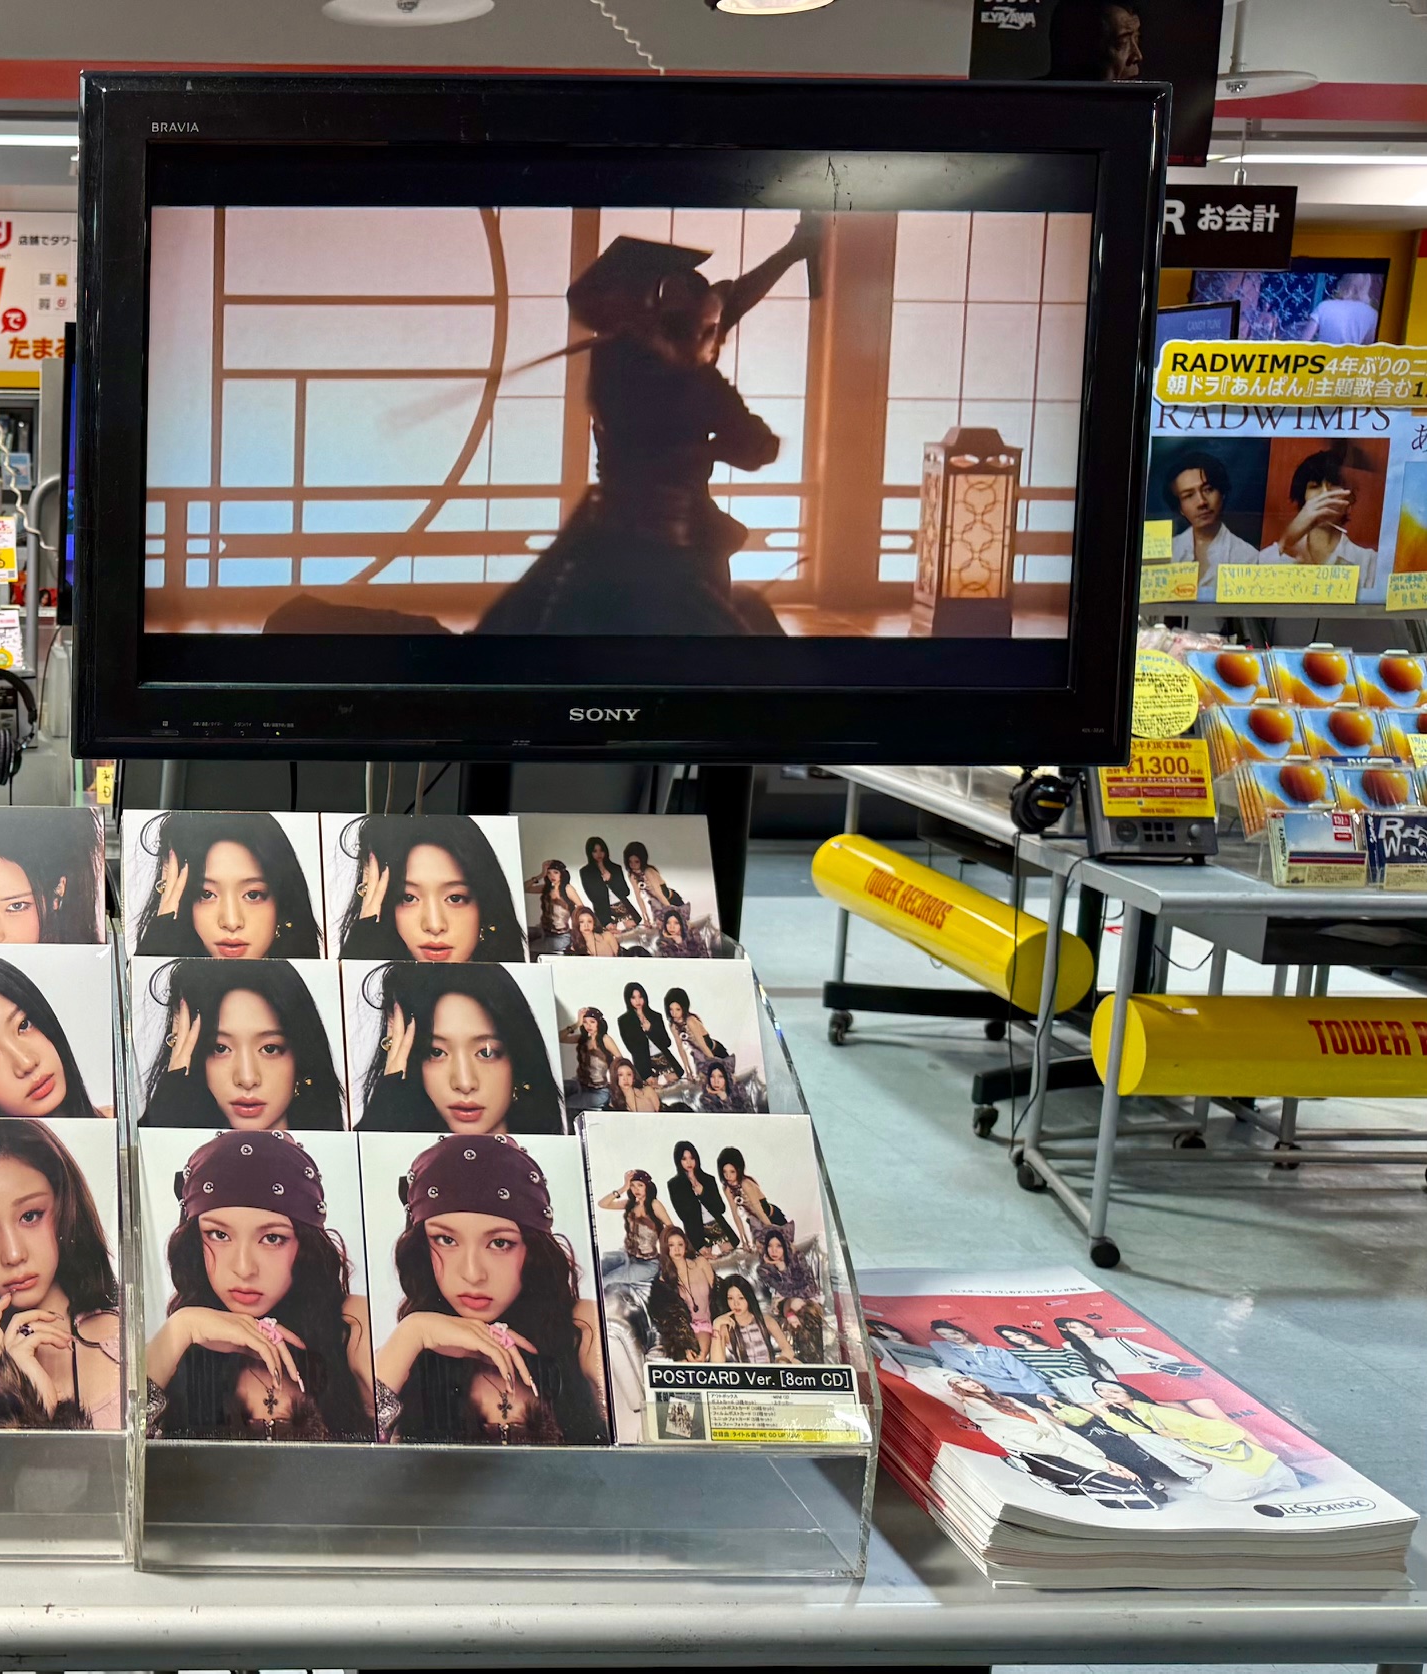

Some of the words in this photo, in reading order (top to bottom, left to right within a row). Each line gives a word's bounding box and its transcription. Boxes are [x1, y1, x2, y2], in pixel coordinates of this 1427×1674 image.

[151, 121, 200, 133] BRAVIA
[1196, 203, 1281, 233] お会計
[1155, 404, 1391, 432] RADWIMPS
[569, 708, 641, 721] SONY
[863, 867, 905, 906] TOWER
[896, 884, 954, 930] RECORDS
[1307, 1019, 1412, 1056] TOWER
[652, 1369, 741, 1386] POSTCARD
[744, 1371, 776, 1387] Ver.
[779, 1369, 817, 1388] [8cm
[820, 1371, 850, 1389] CD]
